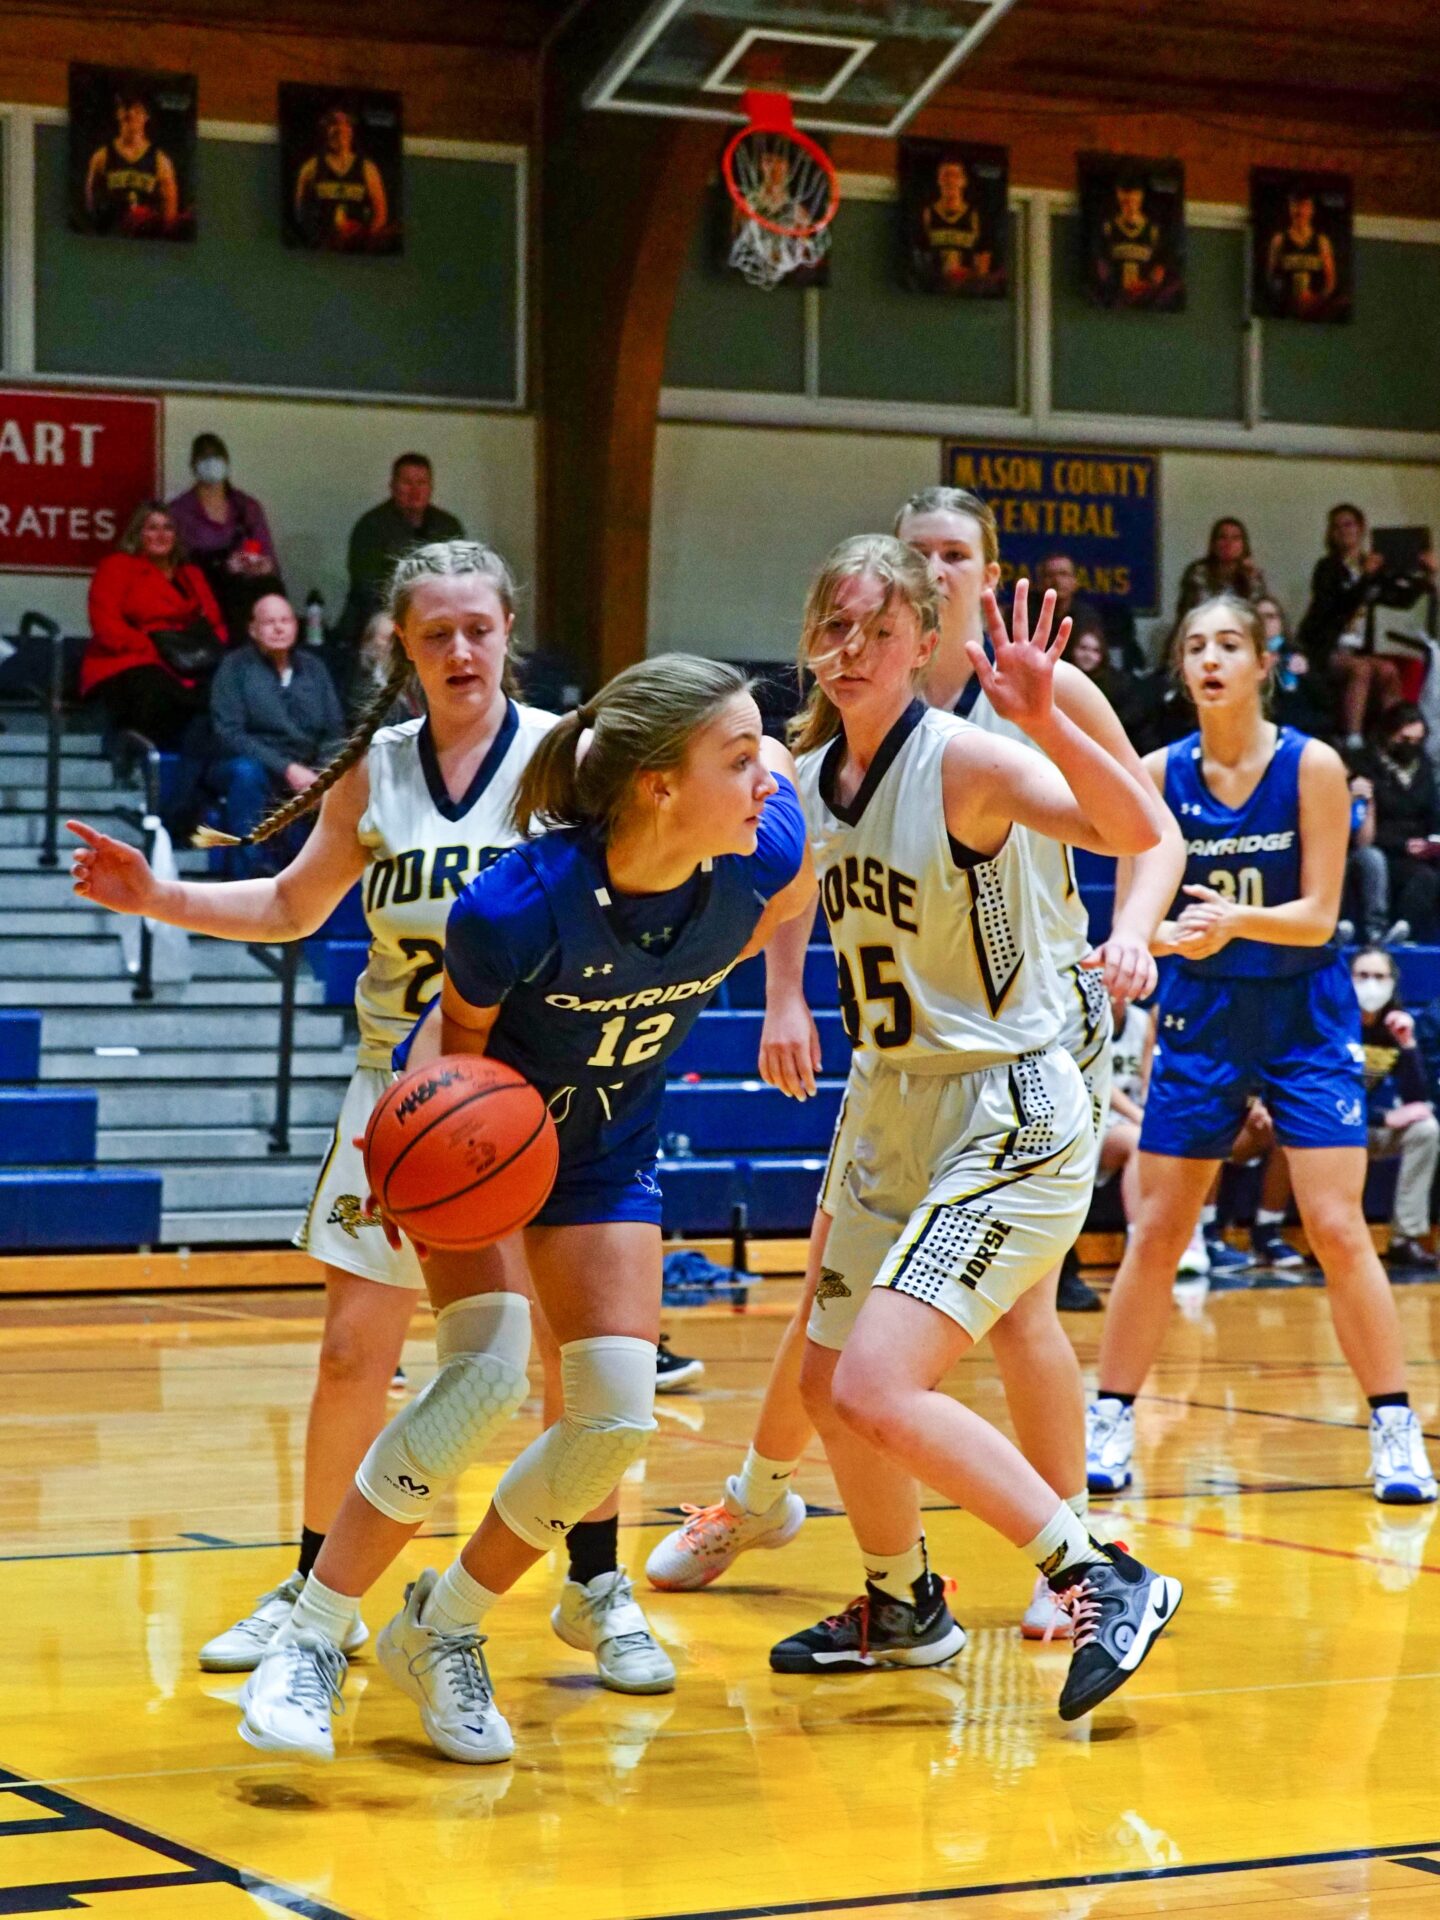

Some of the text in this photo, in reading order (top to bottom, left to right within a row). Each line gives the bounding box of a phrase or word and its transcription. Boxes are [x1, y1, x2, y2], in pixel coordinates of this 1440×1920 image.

[0, 419, 105, 468] ART
[955, 455, 1147, 496] MASON COUNTY
[586, 1012, 676, 1067] 12
